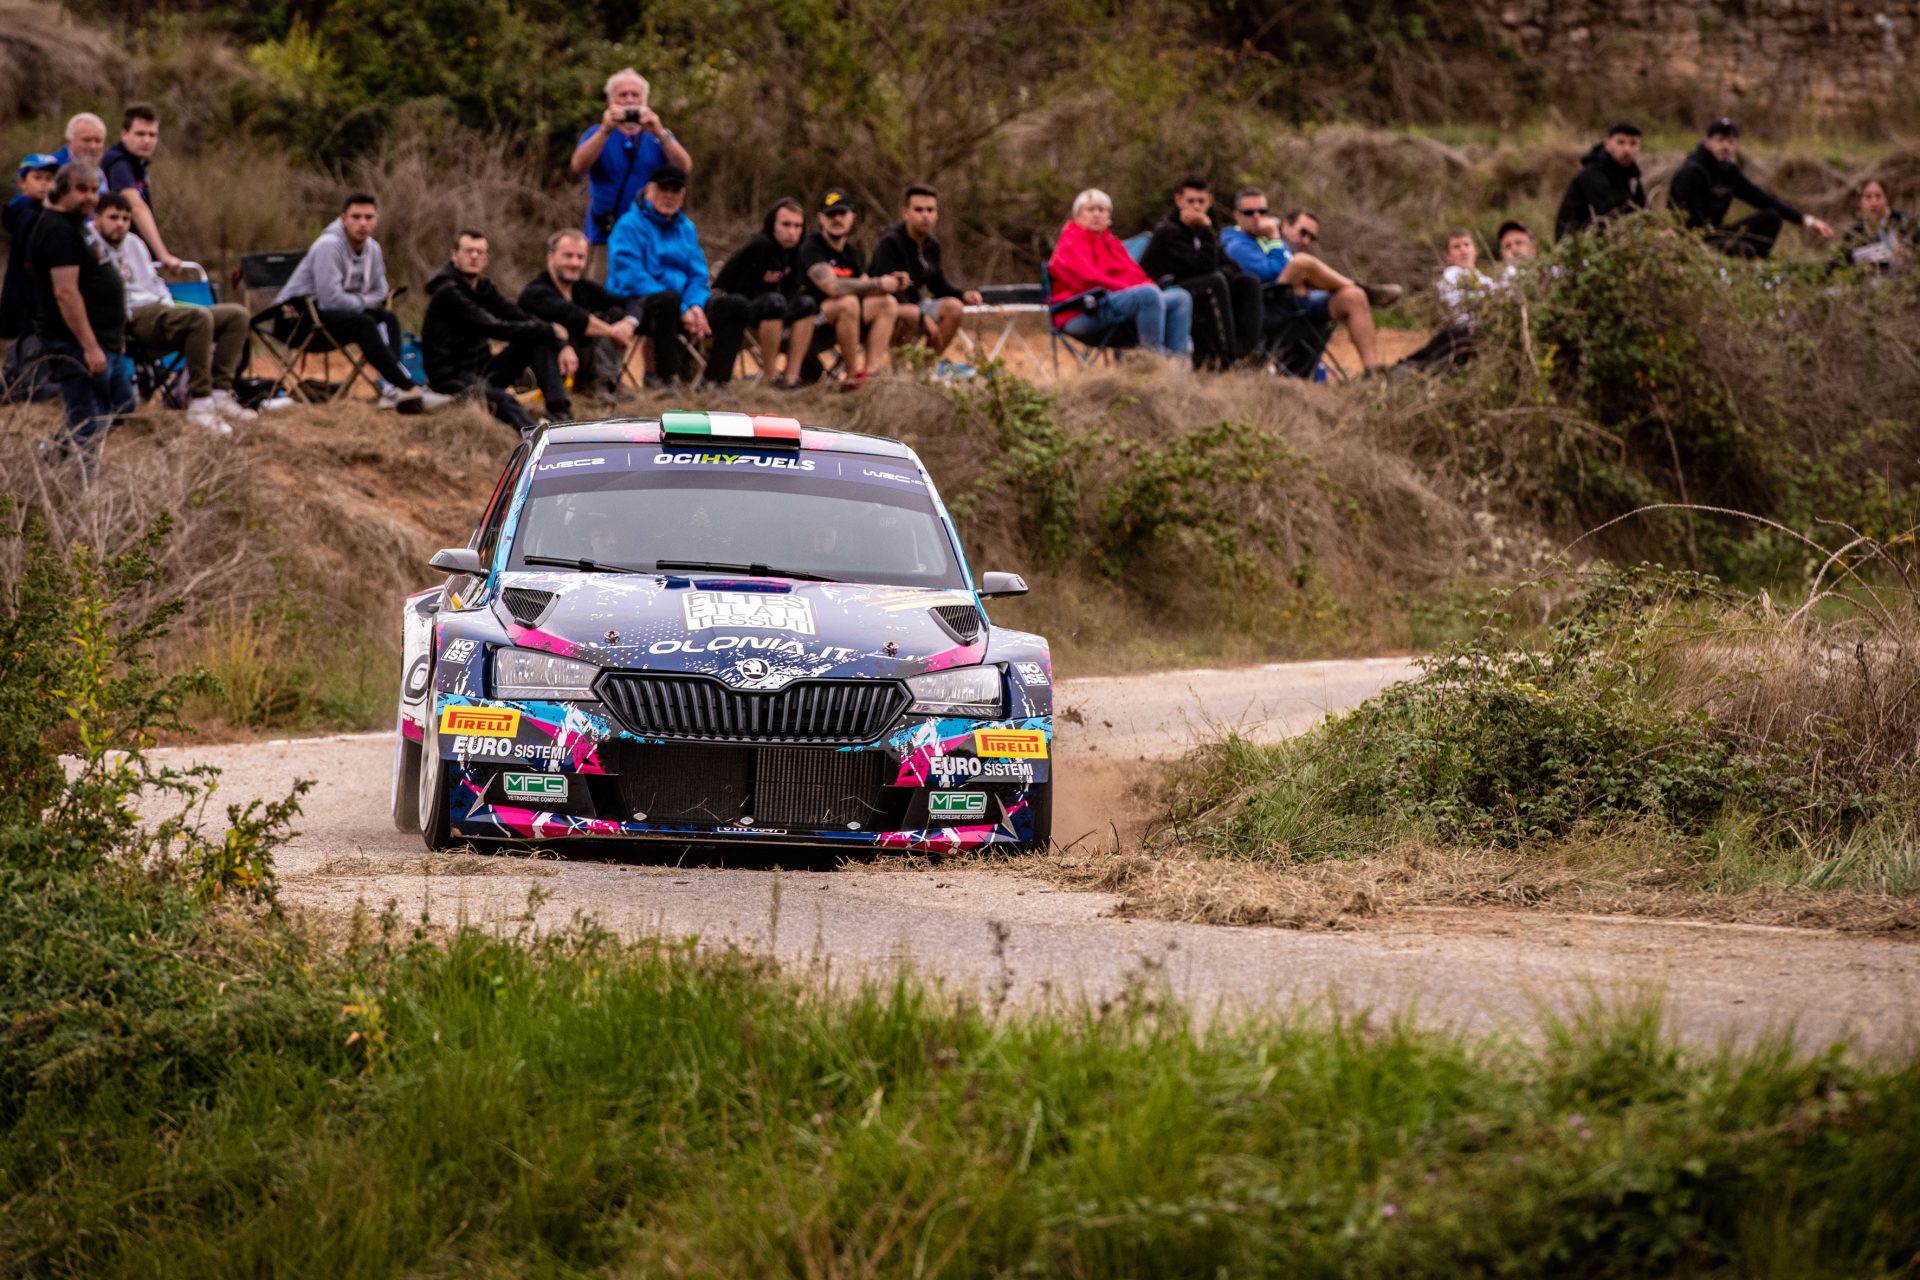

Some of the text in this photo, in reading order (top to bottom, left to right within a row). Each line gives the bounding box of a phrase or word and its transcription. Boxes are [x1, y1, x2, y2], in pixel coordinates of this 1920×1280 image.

[687, 592, 806, 610] FILTES
[689, 604, 809, 622] FILATI
[691, 615, 811, 633] TESSUTI
[448, 711, 514, 732] PIRELLI
[452, 736, 567, 760] EURO SISTEMI
[981, 734, 1040, 753] PIRELLI
[930, 757, 1034, 776] EURO SISTEMI
[505, 775, 564, 793] MPG
[931, 793, 986, 810] MPG
